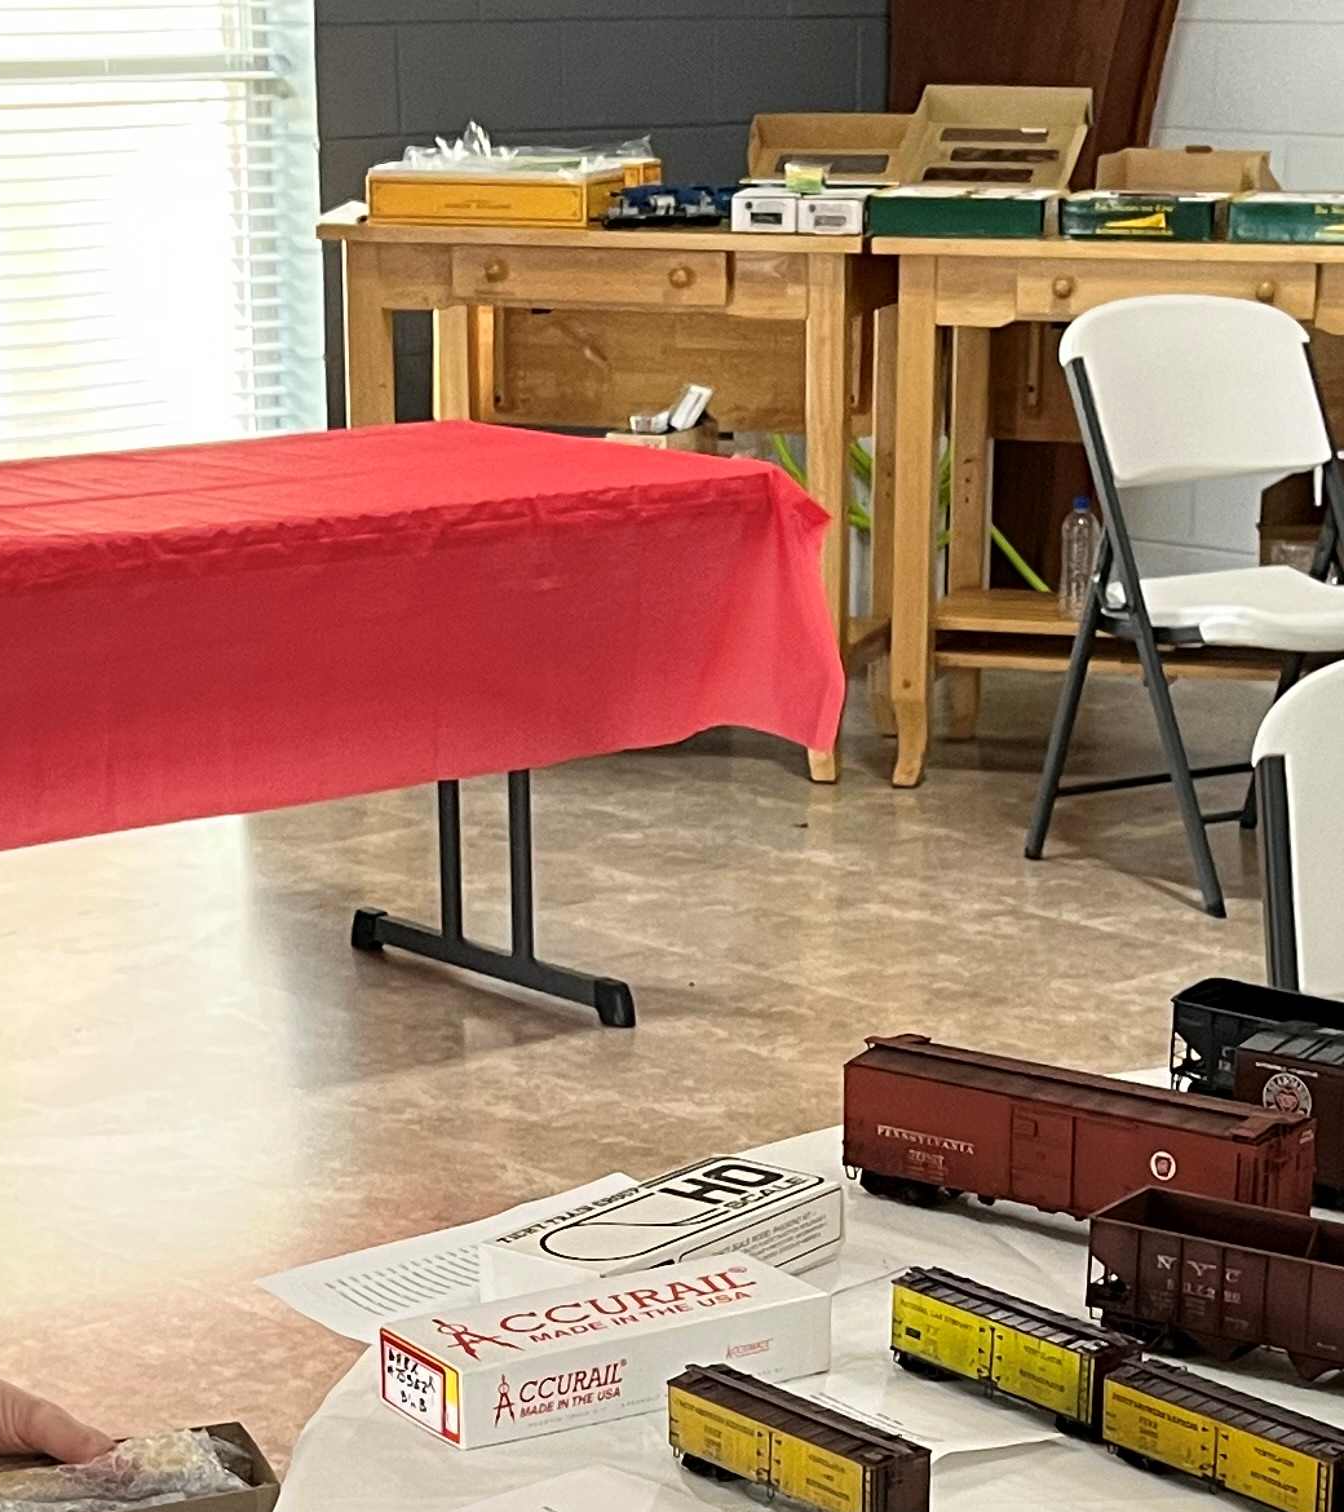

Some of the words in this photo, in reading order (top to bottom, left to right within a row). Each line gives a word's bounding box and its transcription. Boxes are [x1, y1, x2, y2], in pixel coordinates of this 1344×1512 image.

[877, 1124, 975, 1155] PENNSYLVANIA
[658, 1164, 784, 1205] HO
[723, 1176, 811, 1210] SCALE
[432, 1270, 757, 1361] ACCURAIL
[529, 1321, 609, 1344] MADE
[612, 1314, 641, 1327] IN
[642, 1303, 691, 1320] THE
[697, 1291, 752, 1307] USA
[493, 1362, 623, 1428] ACCURAIL
[520, 1402, 554, 1418] MADE
[557, 1399, 570, 1410] IN
[572, 1392, 594, 1407] THE
[598, 1387, 621, 1402] USA
